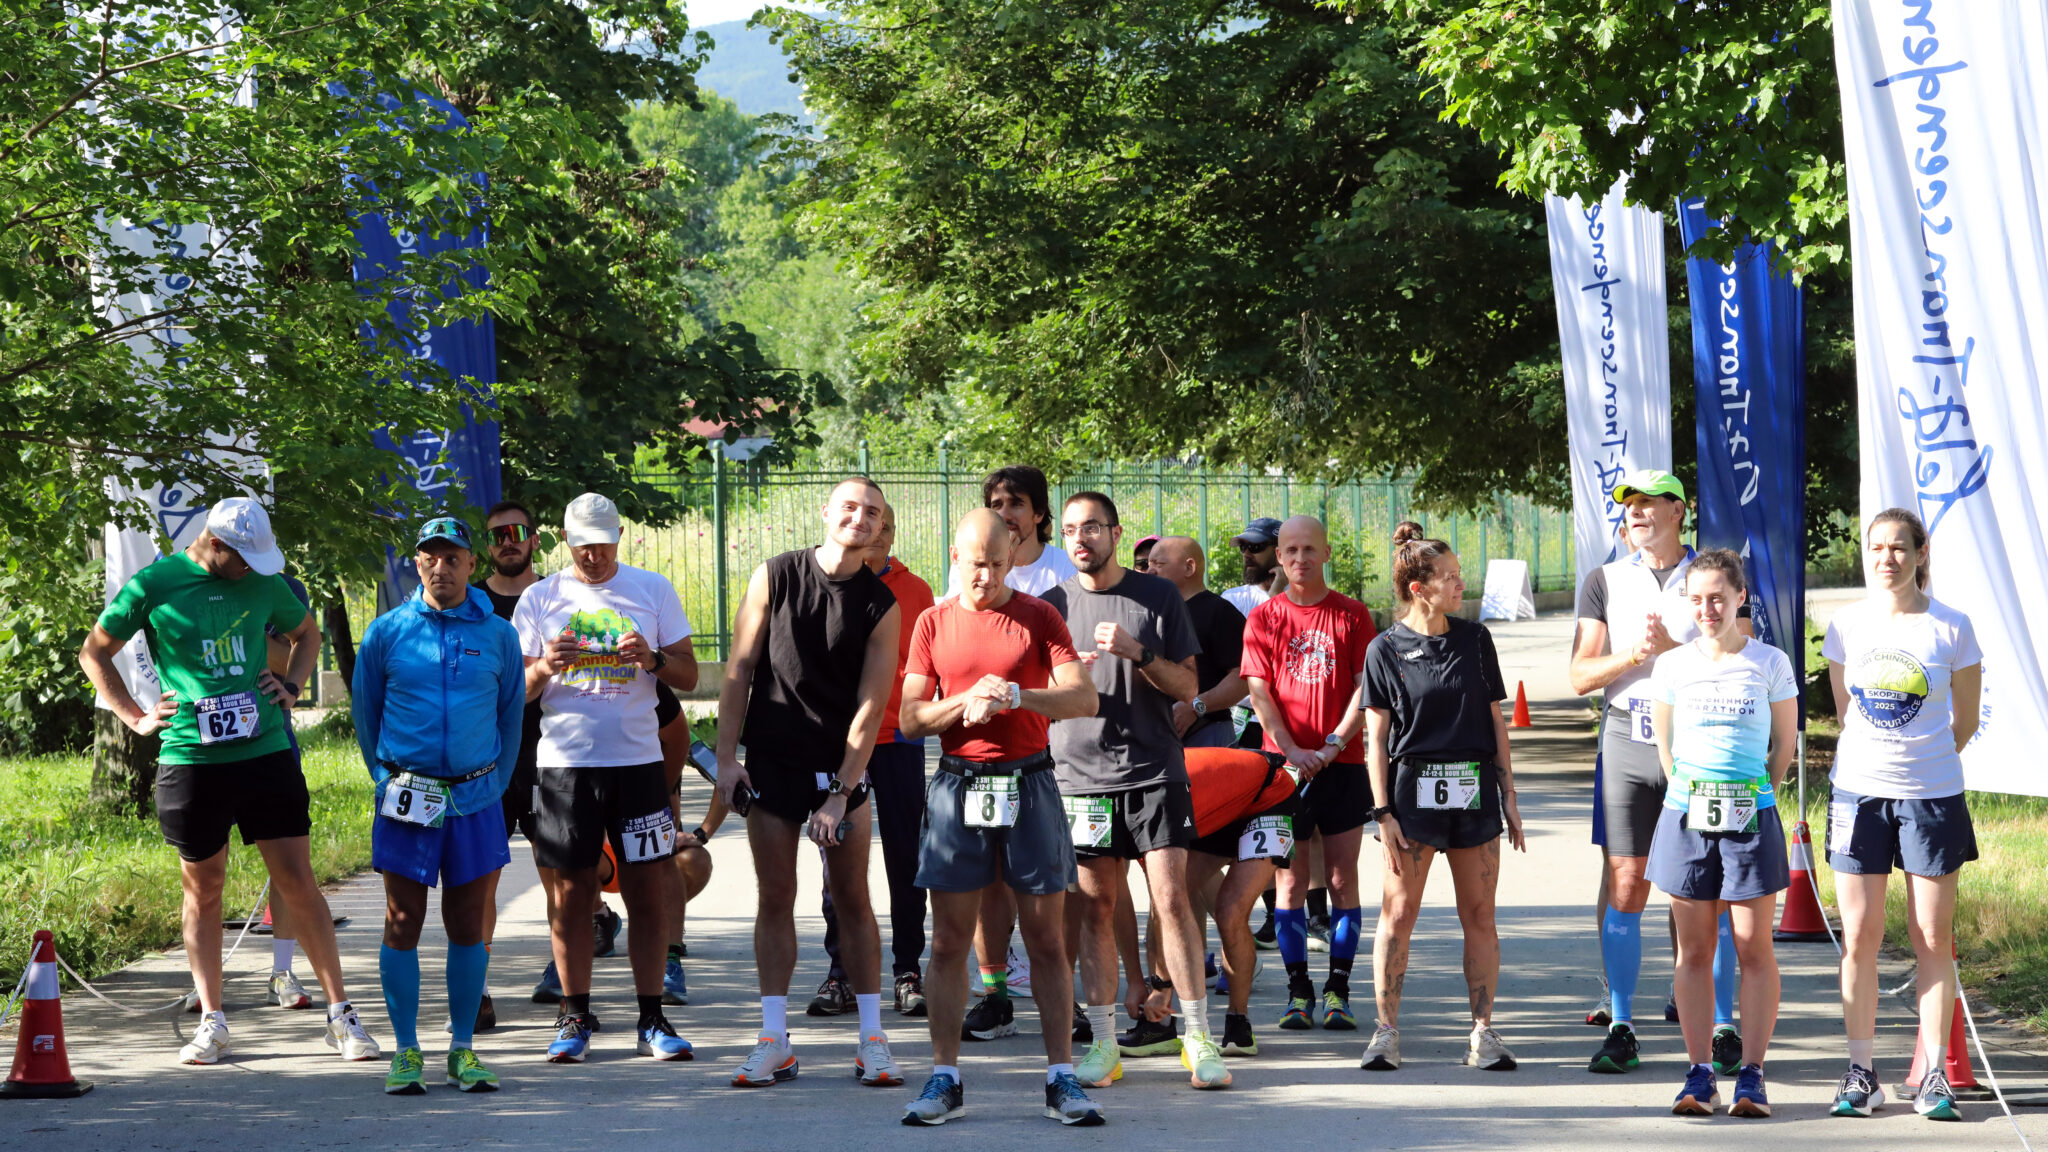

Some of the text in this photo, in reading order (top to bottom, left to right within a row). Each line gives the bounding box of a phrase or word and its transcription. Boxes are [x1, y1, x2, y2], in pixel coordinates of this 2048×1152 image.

[202, 635, 246, 666] RUN
[564, 666, 636, 684] MARATHON
[1874, 653, 1921, 675] CHINMOY
[1868, 690, 1903, 700] SKOPJE
[1874, 702, 1895, 710] 2025
[1687, 704, 1756, 715] MARATHON
[1874, 719, 1902, 728] HOUR
[1903, 699, 1922, 722] RACE
[209, 710, 238, 737] 62
[1640, 715, 1655, 739] 6
[396, 789, 412, 816] 9
[1434, 779, 1448, 805] 6
[982, 793, 995, 822] 8
[1707, 799, 1722, 827] 5
[634, 829, 660, 857] 71
[1253, 830, 1268, 854] 2
